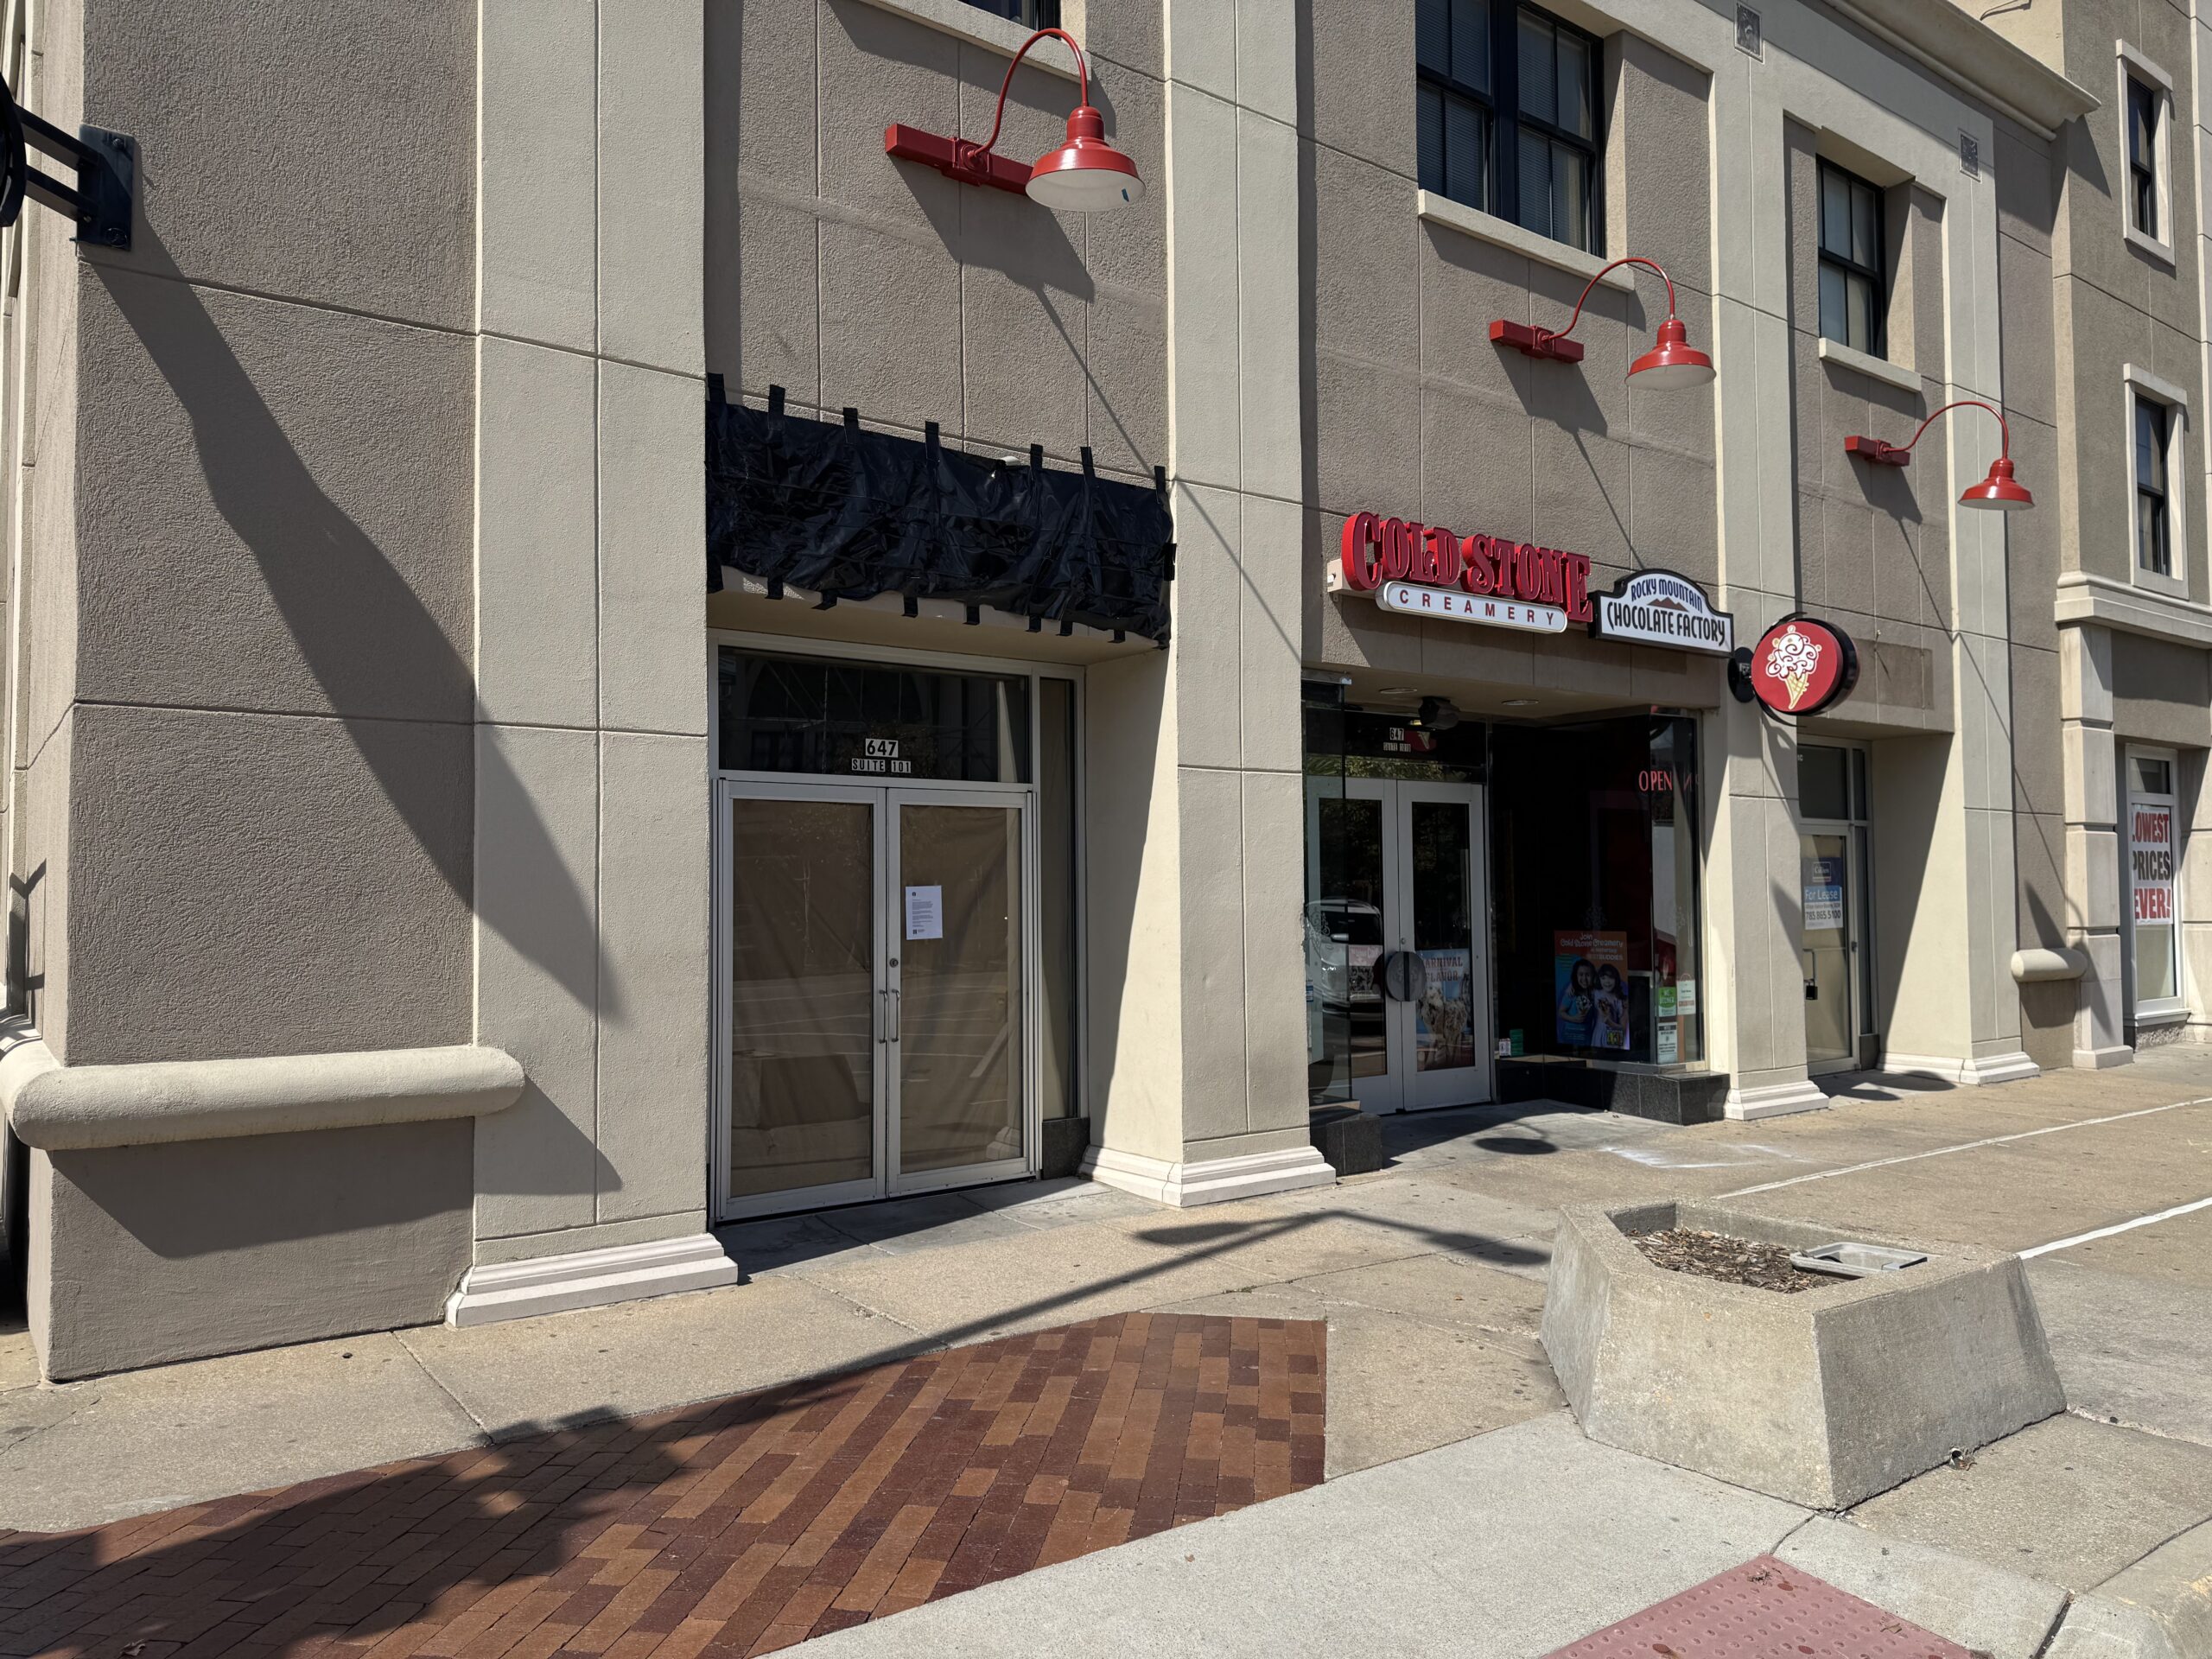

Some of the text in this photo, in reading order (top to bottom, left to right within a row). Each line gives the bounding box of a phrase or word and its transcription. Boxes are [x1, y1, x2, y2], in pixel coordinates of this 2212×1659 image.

[1341, 512, 1593, 622] COLD STONE
[1630, 578, 1703, 613] ROCKY MOUNTAIN
[1399, 589, 1554, 626] CREAMERY
[1607, 601, 1726, 646] CHOCOLATE FACTORY
[1390, 728, 1403, 741] 647
[867, 740, 897, 756] 647
[852, 759, 910, 772] SUITE 101
[1638, 770, 1673, 791] OPEN
[2133, 811, 2169, 843] OWEST
[1805, 889, 1839, 900] For Lease
[2134, 888, 2171, 919] EVER!
[1827, 910, 1841, 919] 5100
[1560, 938, 1573, 947] Cold
[1592, 938, 1624, 948] Creamery
[1580, 932, 1593, 941] Join
[1425, 957, 1463, 968] ARNIVAL
